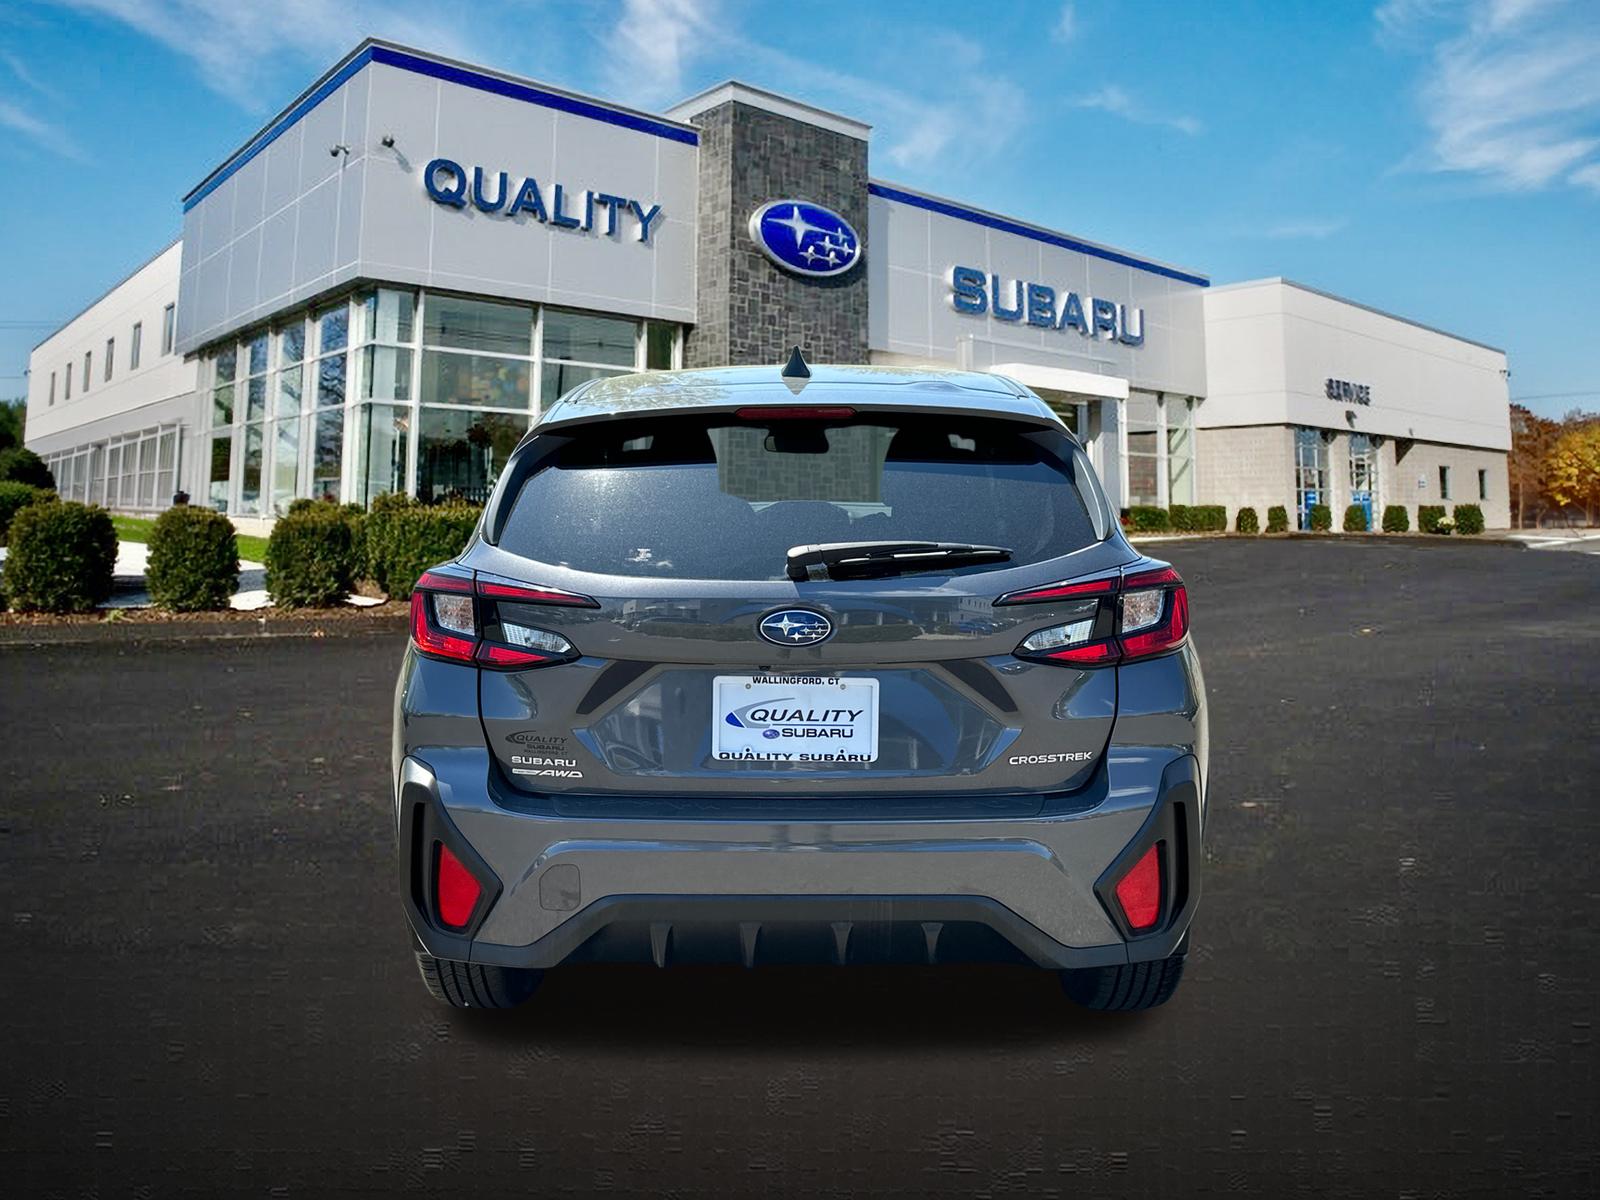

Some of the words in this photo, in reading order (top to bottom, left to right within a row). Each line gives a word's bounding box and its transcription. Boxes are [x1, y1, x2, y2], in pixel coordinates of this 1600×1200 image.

[424, 158, 661, 242] QUALITY
[951, 265, 1145, 347] SUBARU
[827, 677, 841, 686] CT
[750, 708, 864, 723] QUALITY
[516, 734, 569, 744] QUALITY
[781, 728, 854, 739] SUBARU
[526, 743, 566, 751] SUBARU
[511, 755, 577, 767] SUBARU
[718, 751, 792, 761] QUALITY
[799, 753, 872, 763] SUBARU
[1009, 751, 1093, 765] CROSSTREK
[538, 769, 584, 778] AWD
